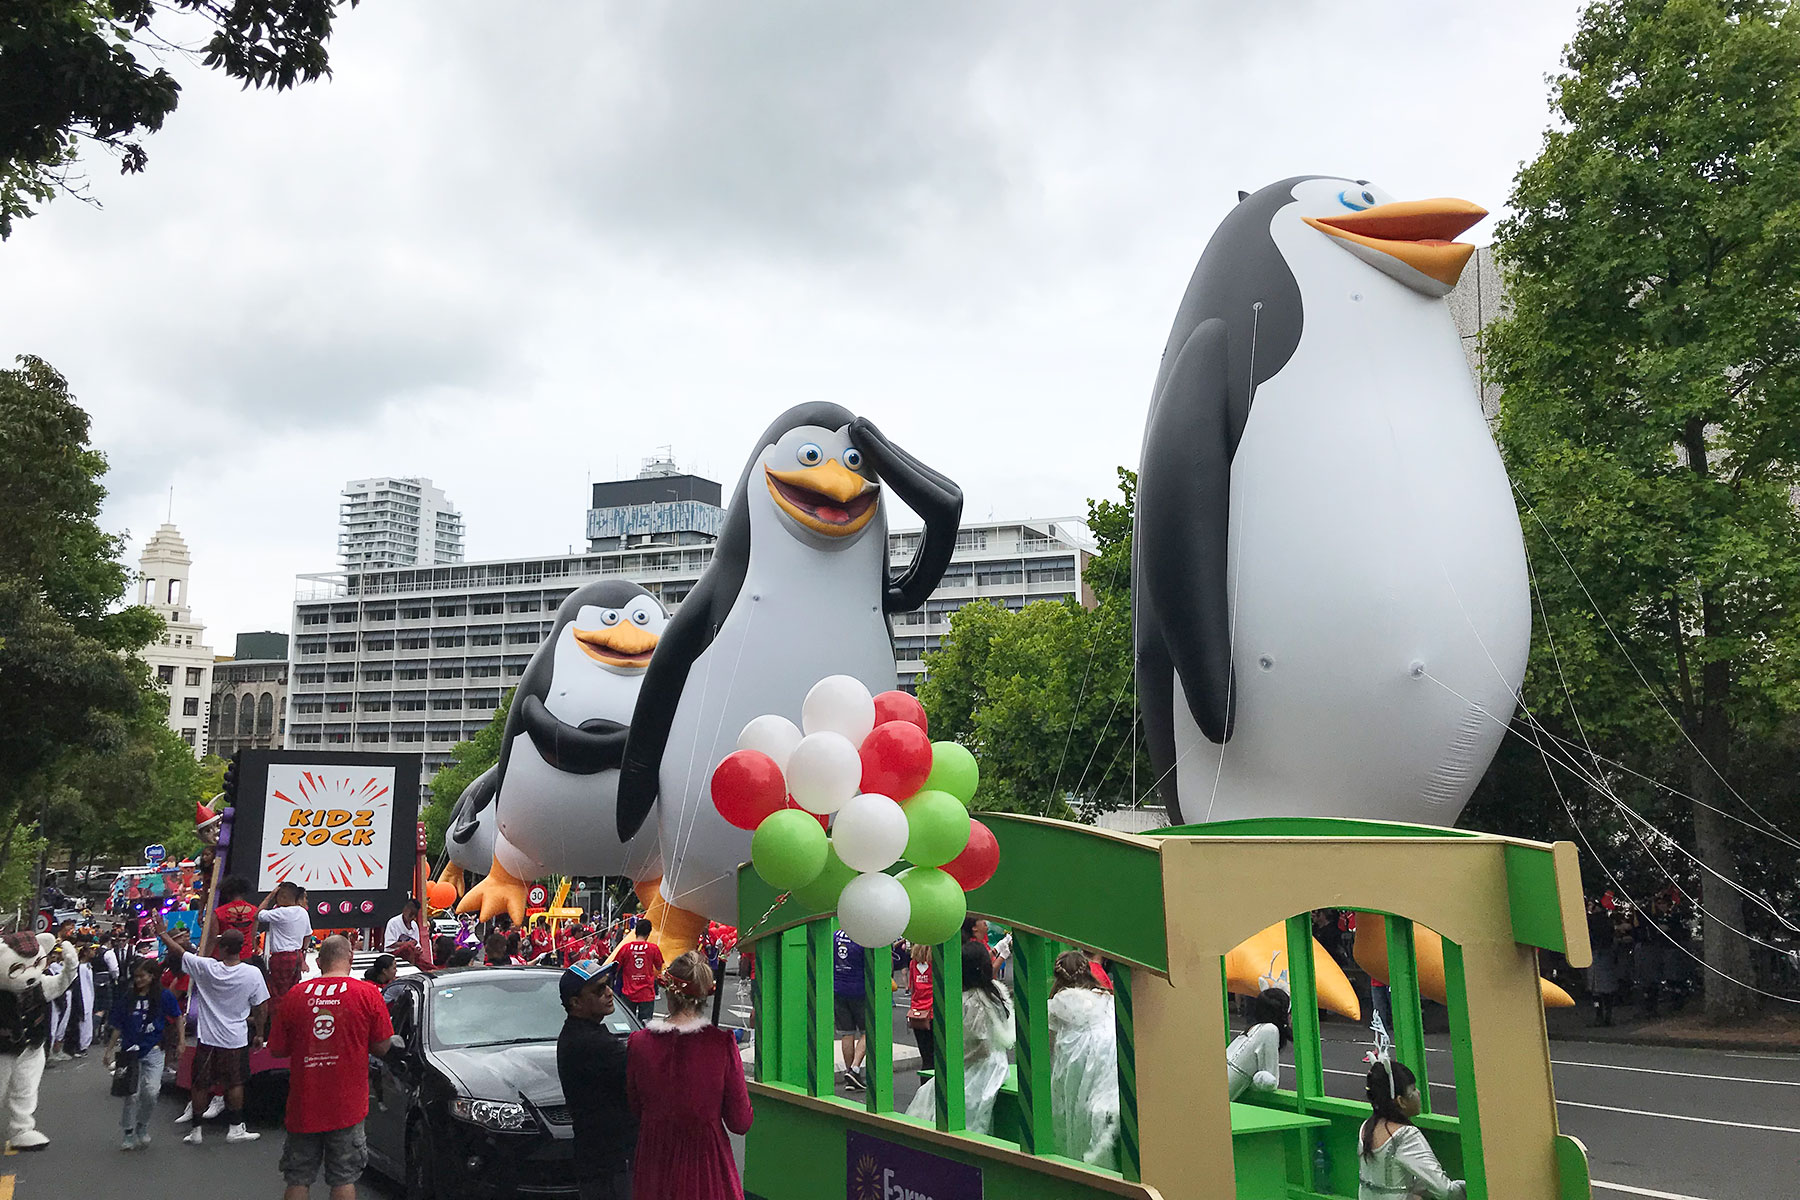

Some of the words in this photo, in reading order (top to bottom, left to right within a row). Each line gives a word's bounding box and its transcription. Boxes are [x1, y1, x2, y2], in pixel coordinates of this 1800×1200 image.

[202, 701, 210, 734] Hotel
[289, 809, 375, 827] KIDZ
[280, 828, 375, 847] ROCK
[531, 891, 543, 901] 30
[315, 998, 341, 1006] Farmers
